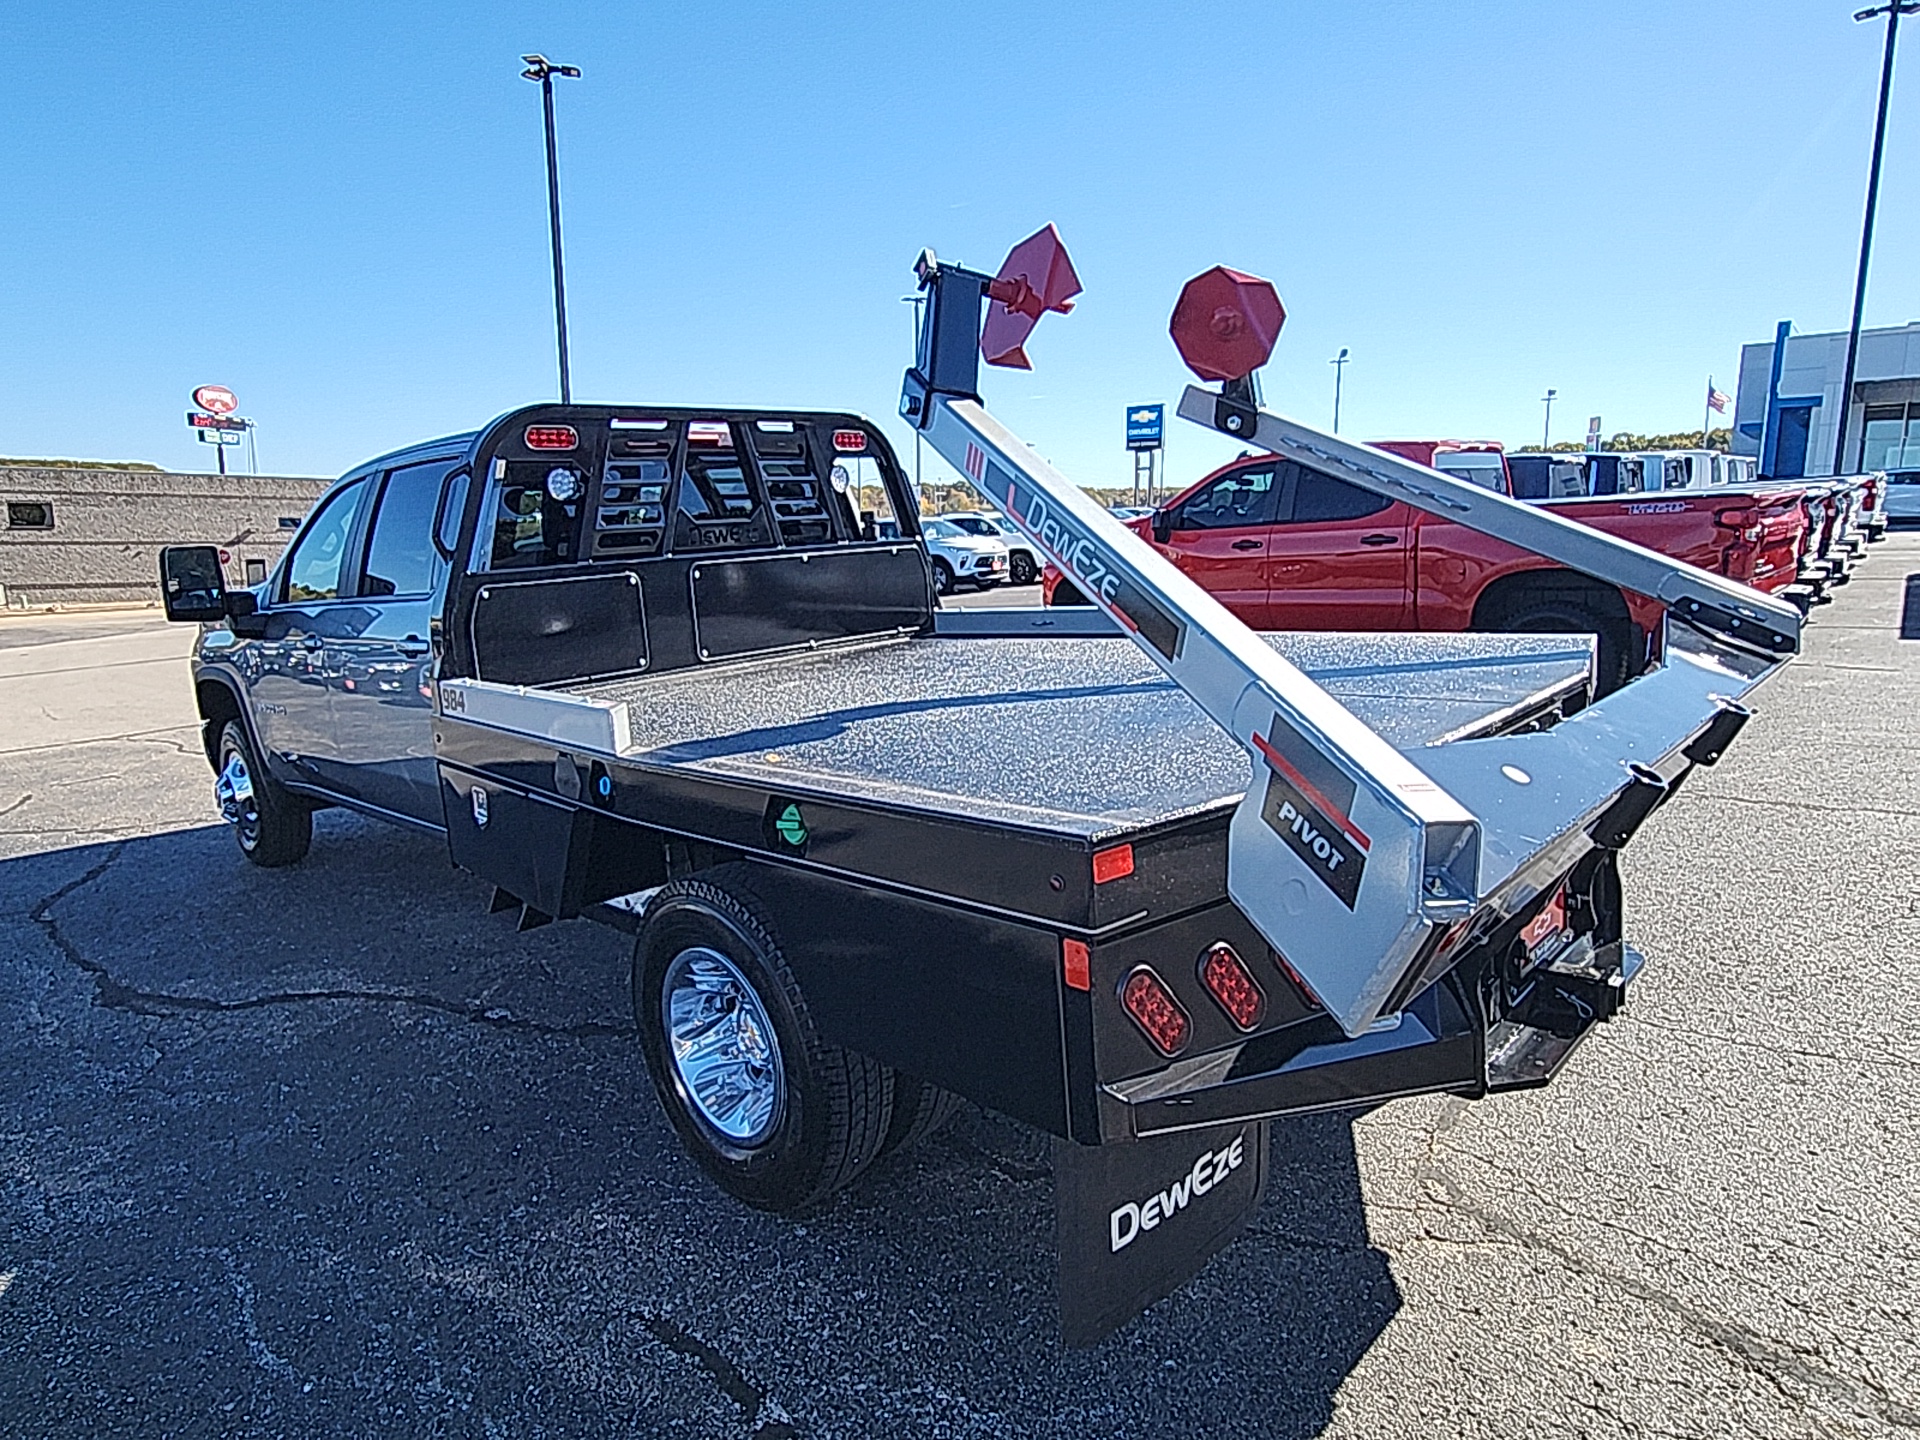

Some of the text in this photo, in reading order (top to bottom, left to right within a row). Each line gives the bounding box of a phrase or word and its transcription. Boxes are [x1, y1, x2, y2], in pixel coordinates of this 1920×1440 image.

[1128, 427, 1160, 436] CHEVROLET
[442, 688, 466, 714] 984
[1278, 801, 1345, 871] PIVOT
